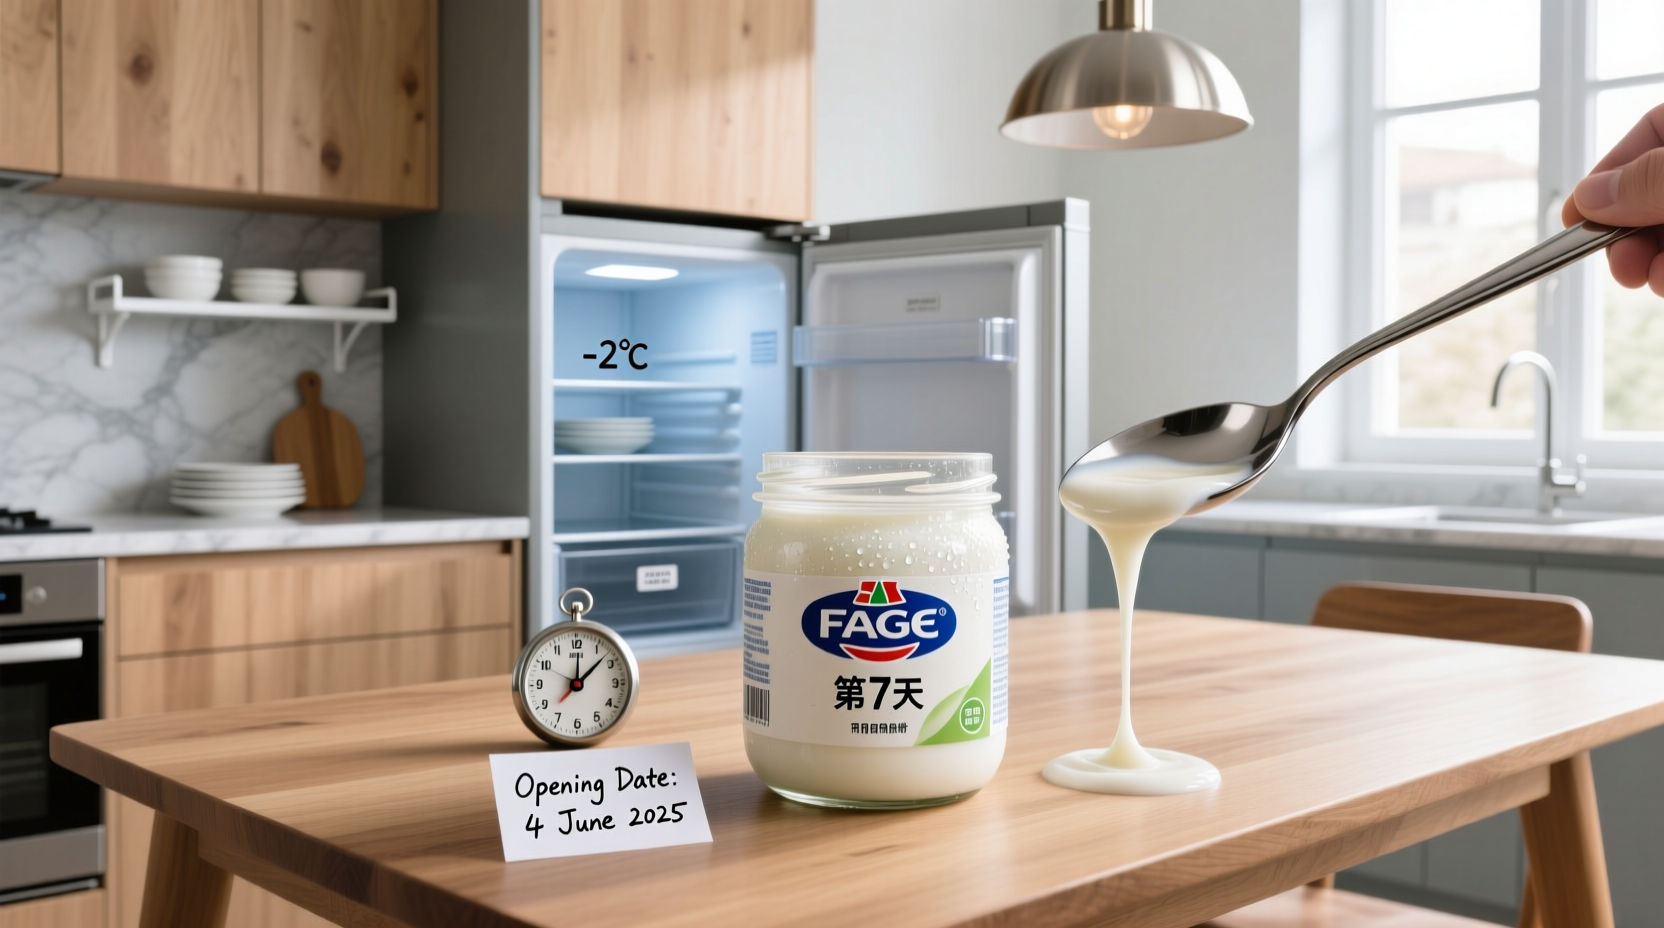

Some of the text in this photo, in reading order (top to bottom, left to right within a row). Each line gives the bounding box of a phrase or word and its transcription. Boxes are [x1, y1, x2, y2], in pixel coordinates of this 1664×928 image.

[820, 608, 939, 639] FAGE
[833, 675, 924, 711] 第7天
[515, 766, 677, 807] Opening Date:
[525, 801, 688, 839] 4 June 2025
